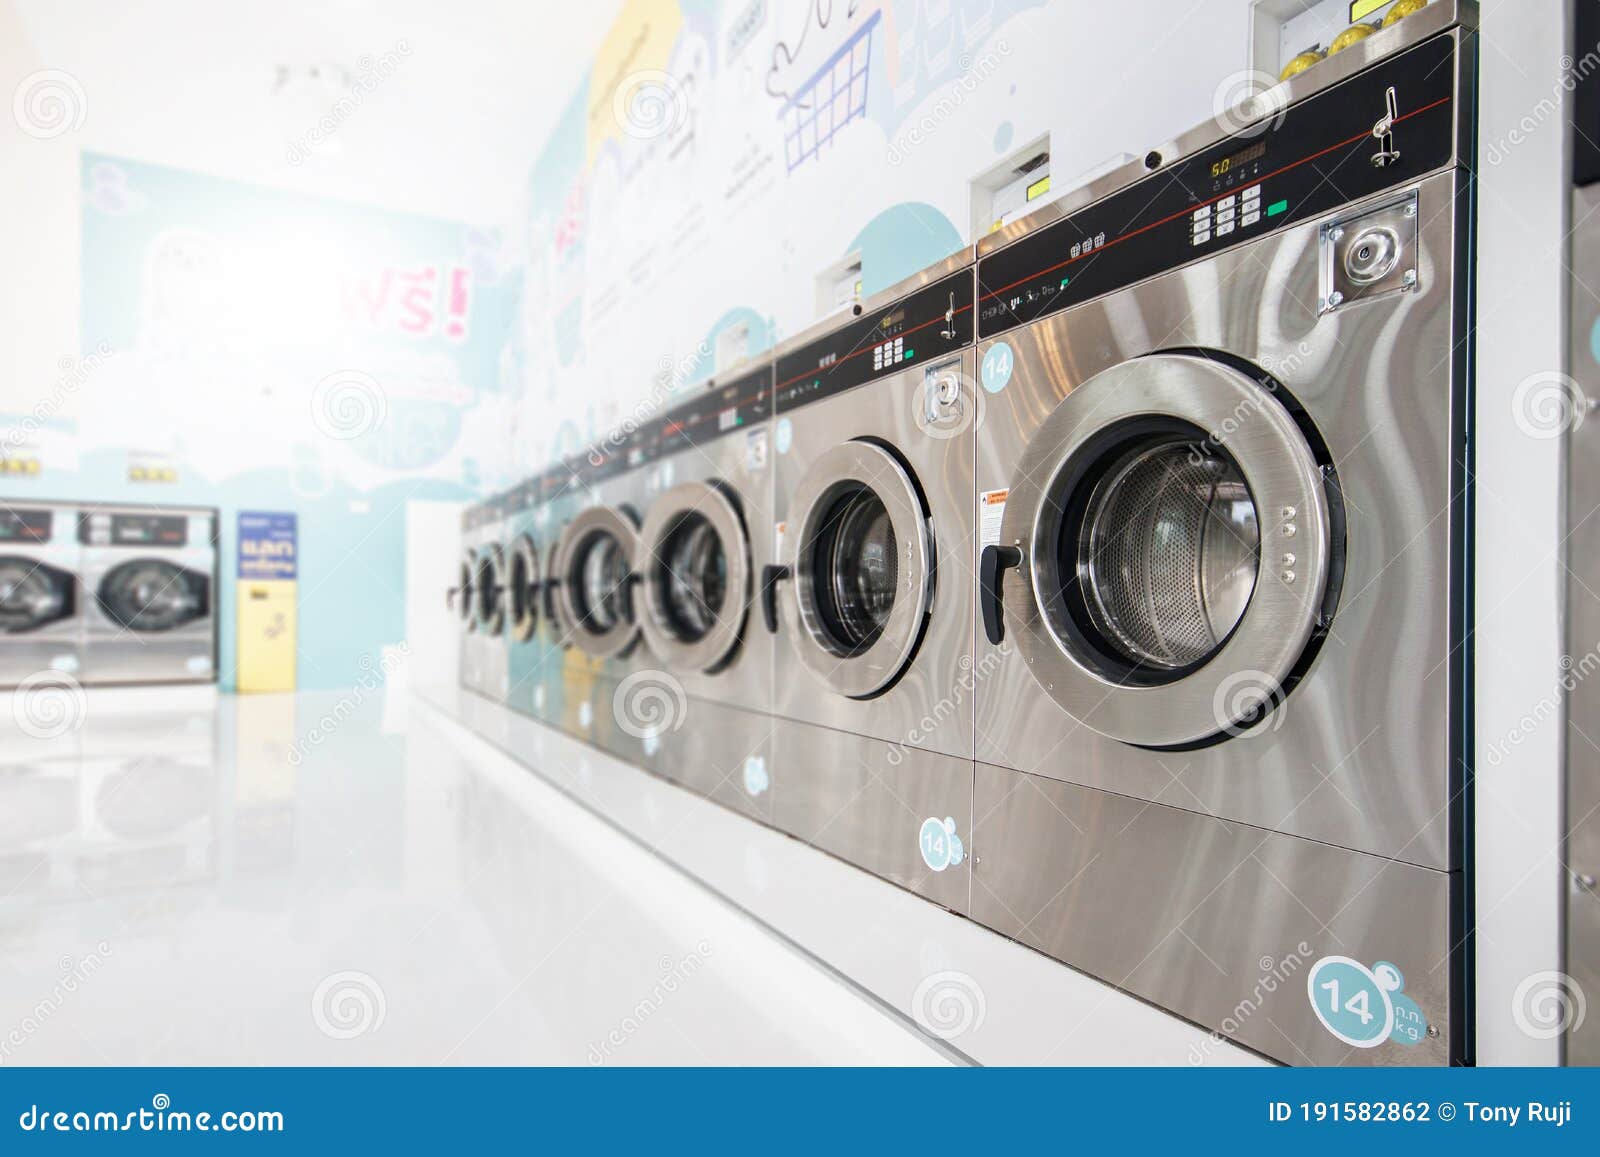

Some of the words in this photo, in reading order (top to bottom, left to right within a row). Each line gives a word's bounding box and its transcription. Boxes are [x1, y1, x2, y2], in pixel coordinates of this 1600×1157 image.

[985, 351, 1009, 381] 14
[923, 831, 945, 857] 14
[1320, 978, 1374, 1025] 14
[1395, 1017, 1422, 1041] k.g.
